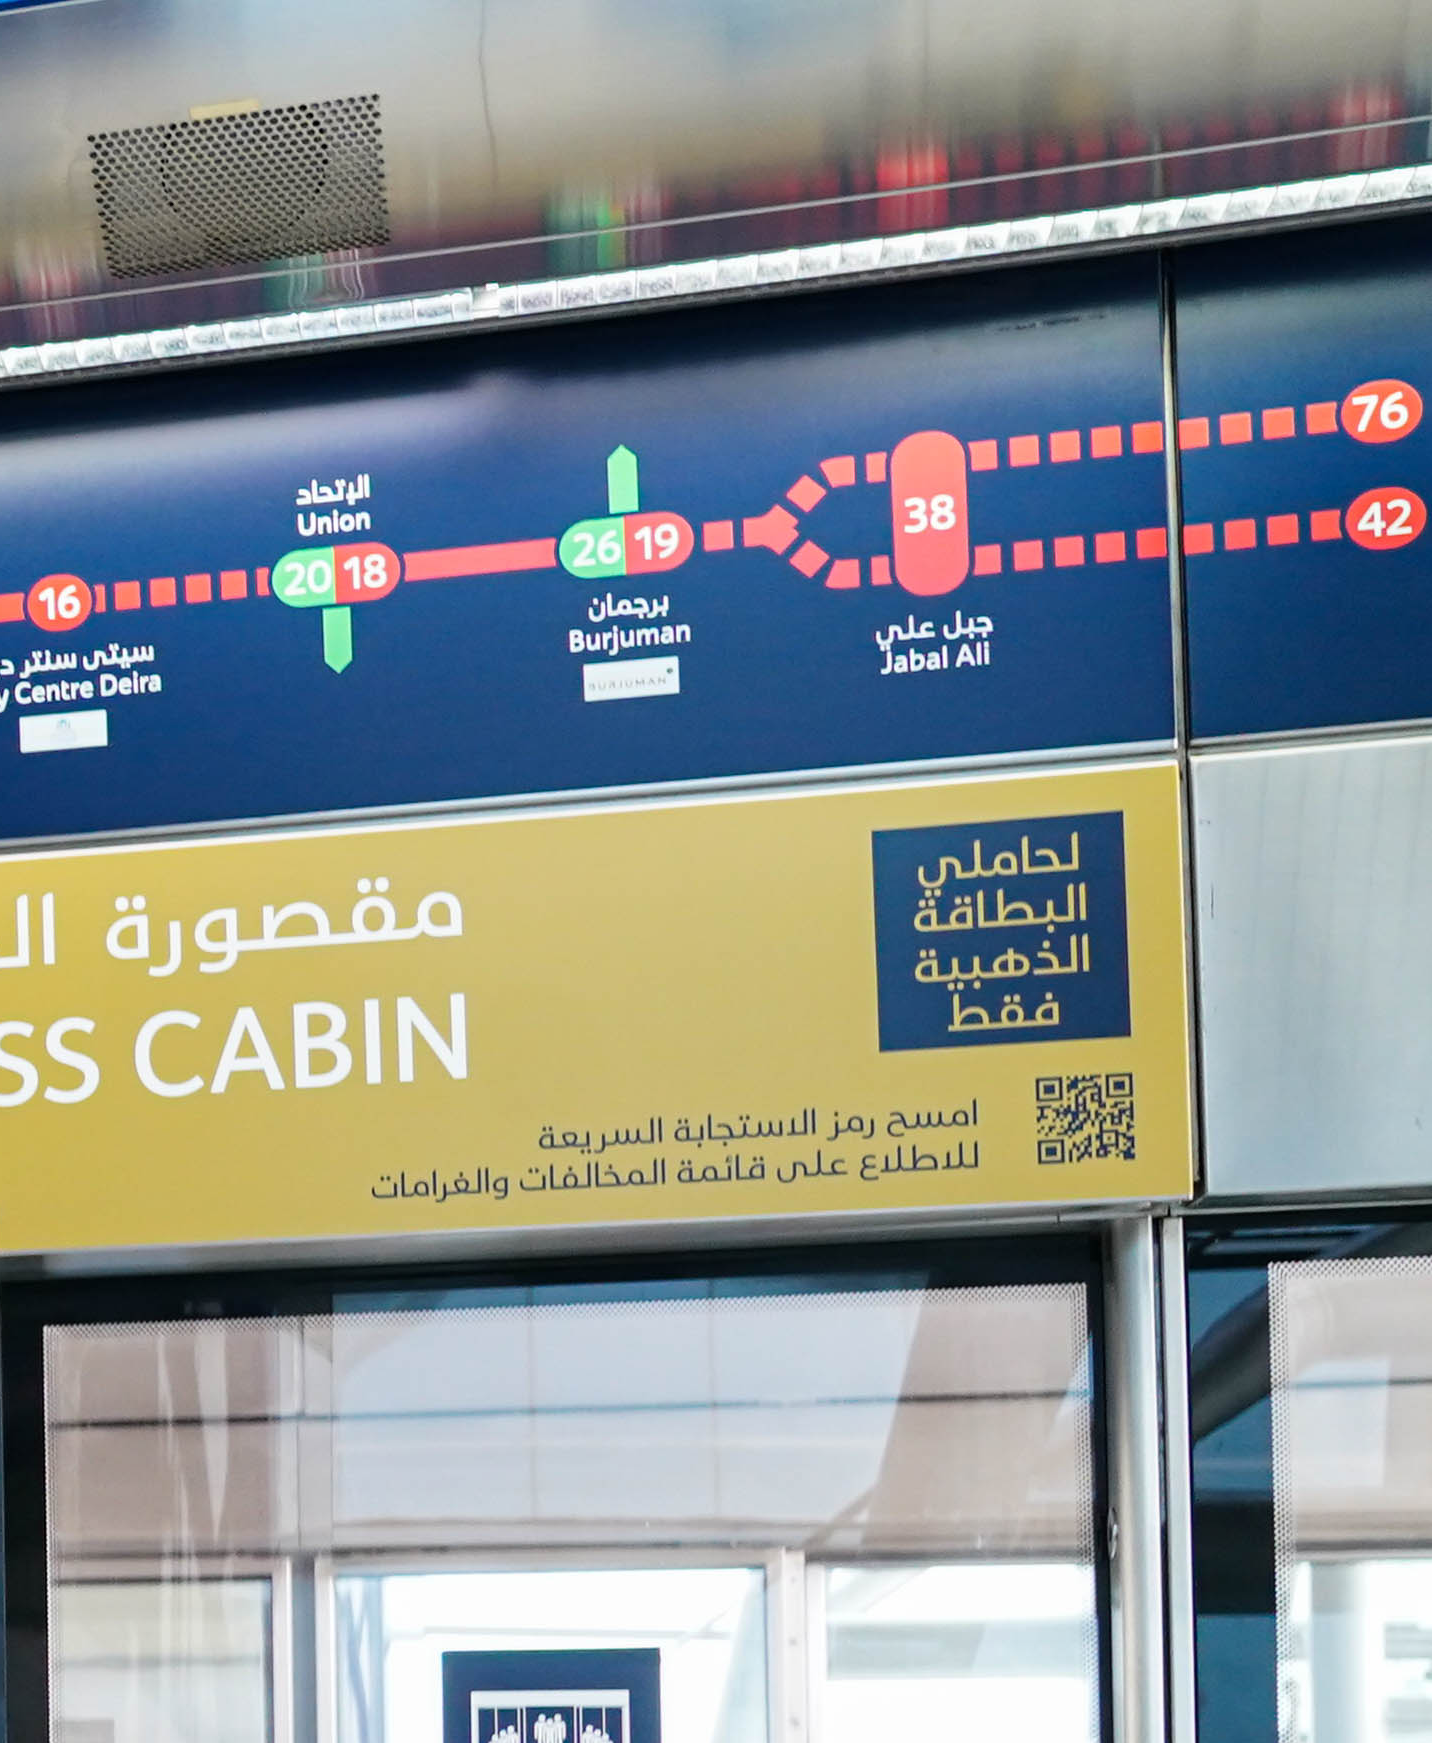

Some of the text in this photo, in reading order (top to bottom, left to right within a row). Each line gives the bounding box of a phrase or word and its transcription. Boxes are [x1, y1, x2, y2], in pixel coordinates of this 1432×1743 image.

[1351, 390, 1409, 433] 76
[297, 508, 371, 537] Union
[903, 493, 957, 534] 38
[1356, 498, 1413, 538] 42
[572, 530, 621, 568] 26
[634, 523, 680, 560] 19
[283, 559, 332, 597] 20
[343, 553, 387, 590] 18
[37, 583, 81, 621] 16
[587, 593, 670, 624] برجمان
[568, 619, 692, 657] Burjuman
[874, 610, 995, 651] جبل علي
[18, 648, 78, 679] سنتر
[879, 637, 991, 676] Jabal Ali
[14, 676, 94, 706] Centre
[99, 670, 162, 699] Deira
[916, 830, 1080, 899] لحاملي
[104, 873, 464, 978] مقصورة
[913, 881, 1087, 934] البطاقة
[913, 932, 1091, 991] الذهبية
[947, 991, 1060, 1033] فقط
[133, 992, 470, 1100] CABIN
[538, 1099, 980, 1155] امسح رمز الاستجابة السريعة
[370, 1144, 981, 1201] للاطلاع على قائمة المخالفات والغرامات
